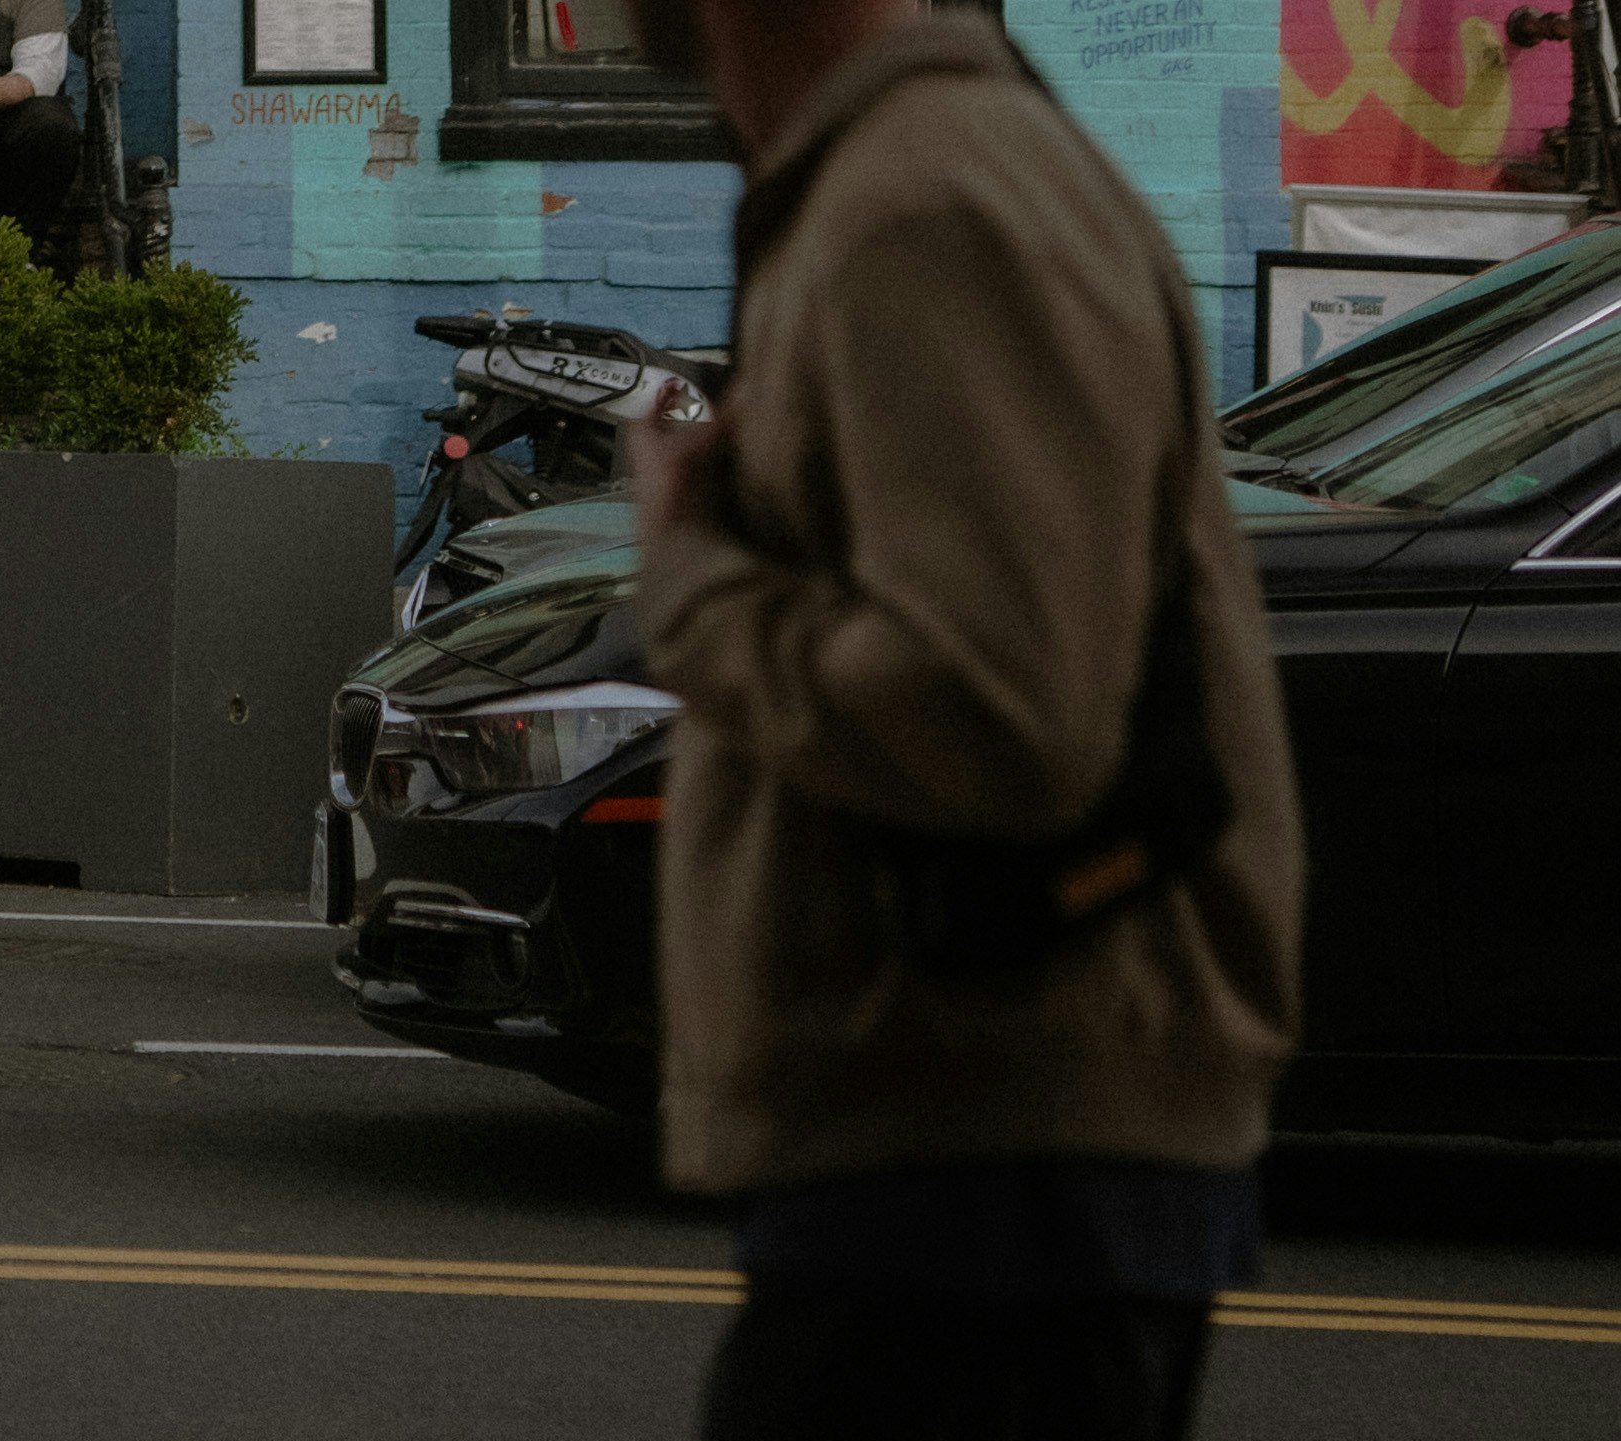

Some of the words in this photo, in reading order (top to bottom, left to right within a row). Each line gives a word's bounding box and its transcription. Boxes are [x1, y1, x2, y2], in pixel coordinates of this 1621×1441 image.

[1096, 2, 1168, 36] NEVER
[1081, 20, 1217, 69] OPPORTUNITY
[231, 92, 401, 126] SHAWARMA
[1352, 302, 1383, 316] Sushi
